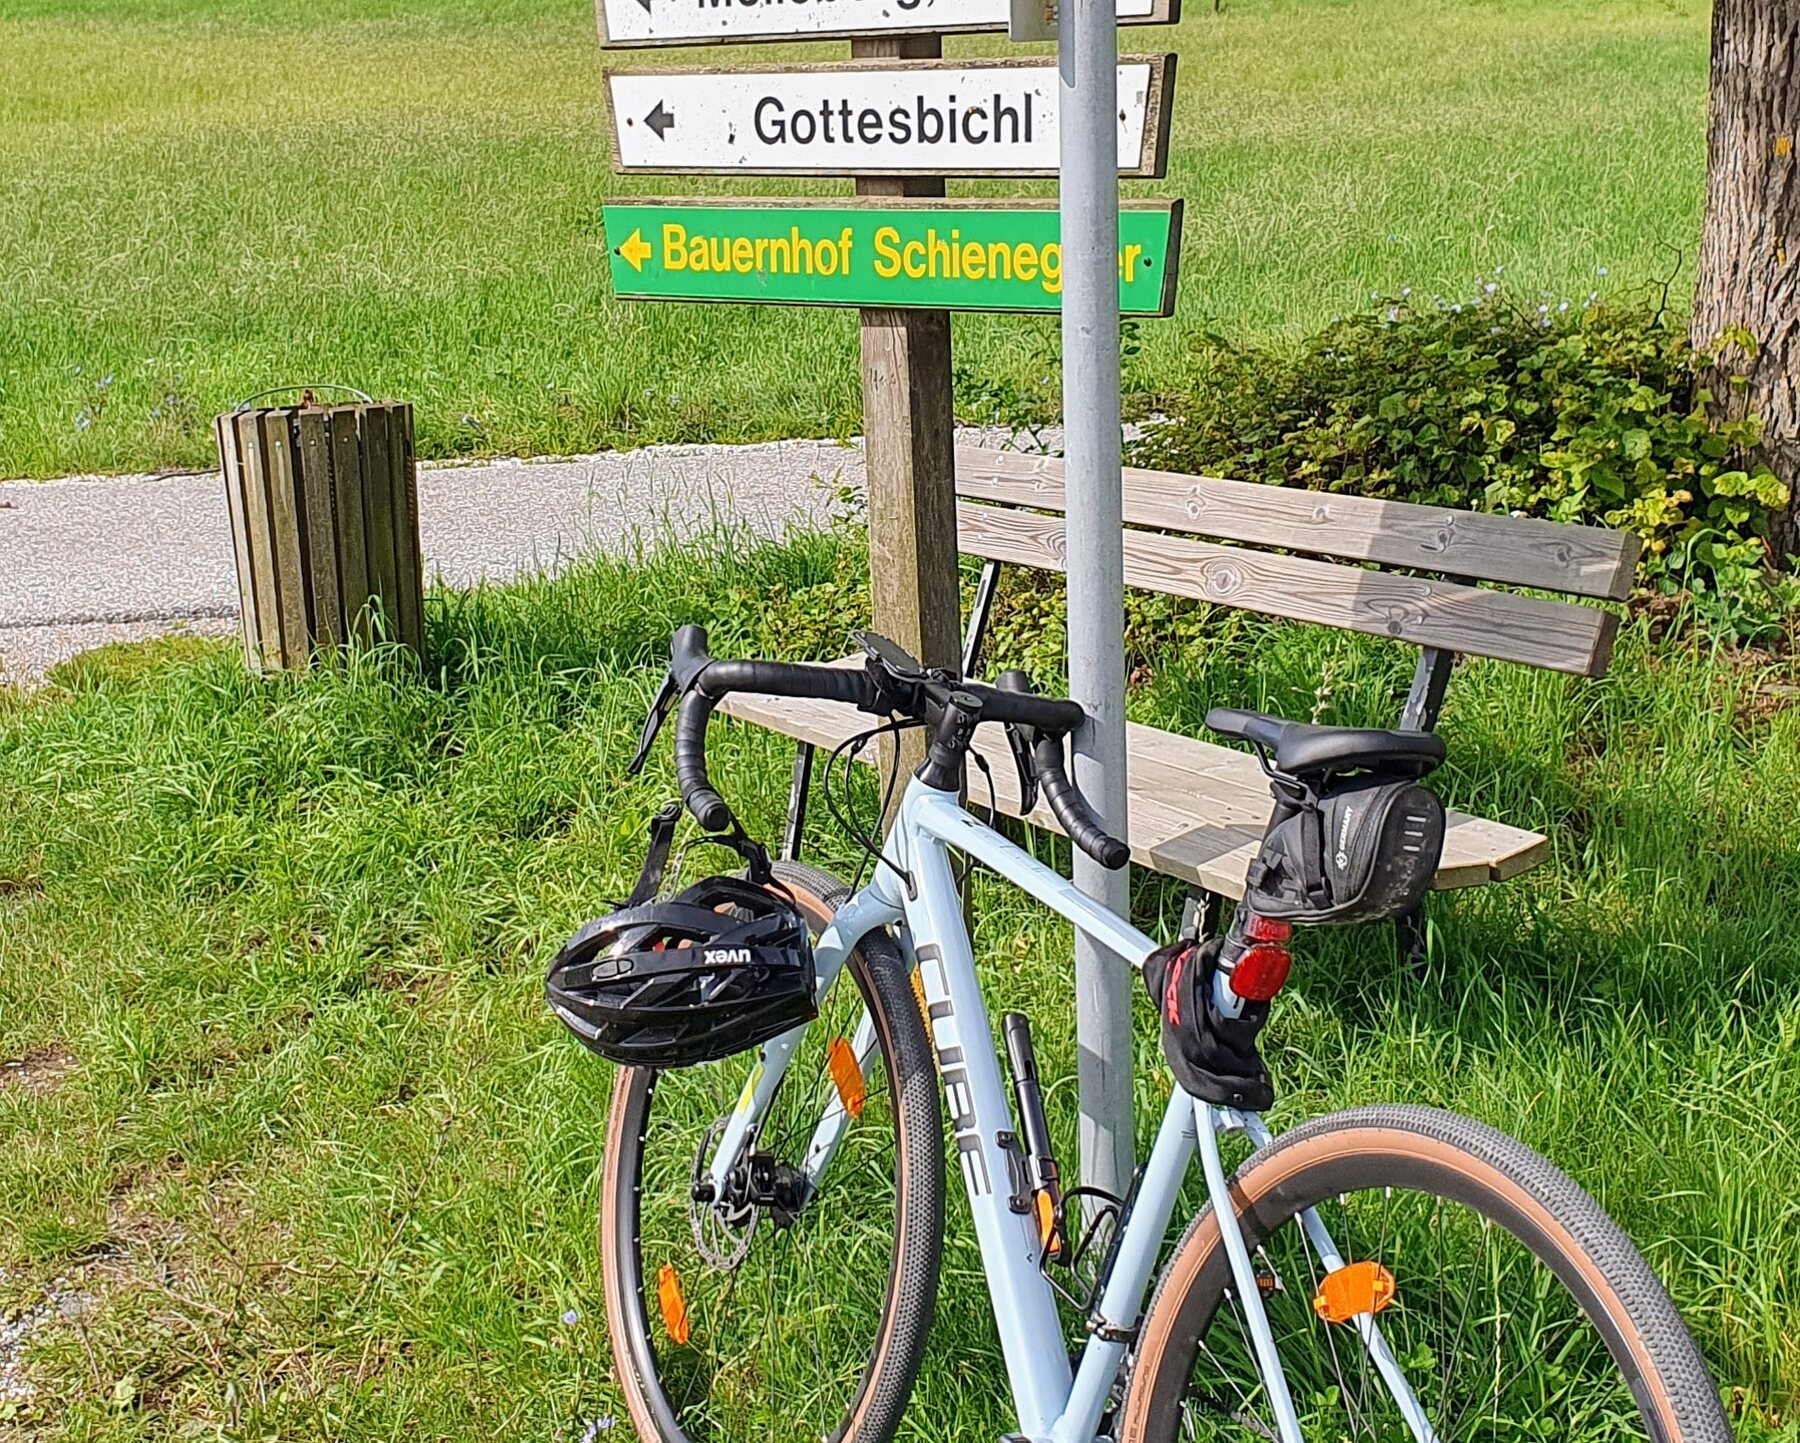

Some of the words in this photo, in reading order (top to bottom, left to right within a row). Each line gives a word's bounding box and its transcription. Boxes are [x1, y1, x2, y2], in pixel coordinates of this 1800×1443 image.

[755, 95, 1033, 145] Gottesbichl
[662, 223, 852, 275] Bauernhof
[874, 226, 1141, 293] Schienegr
[704, 949, 751, 964] uvex
